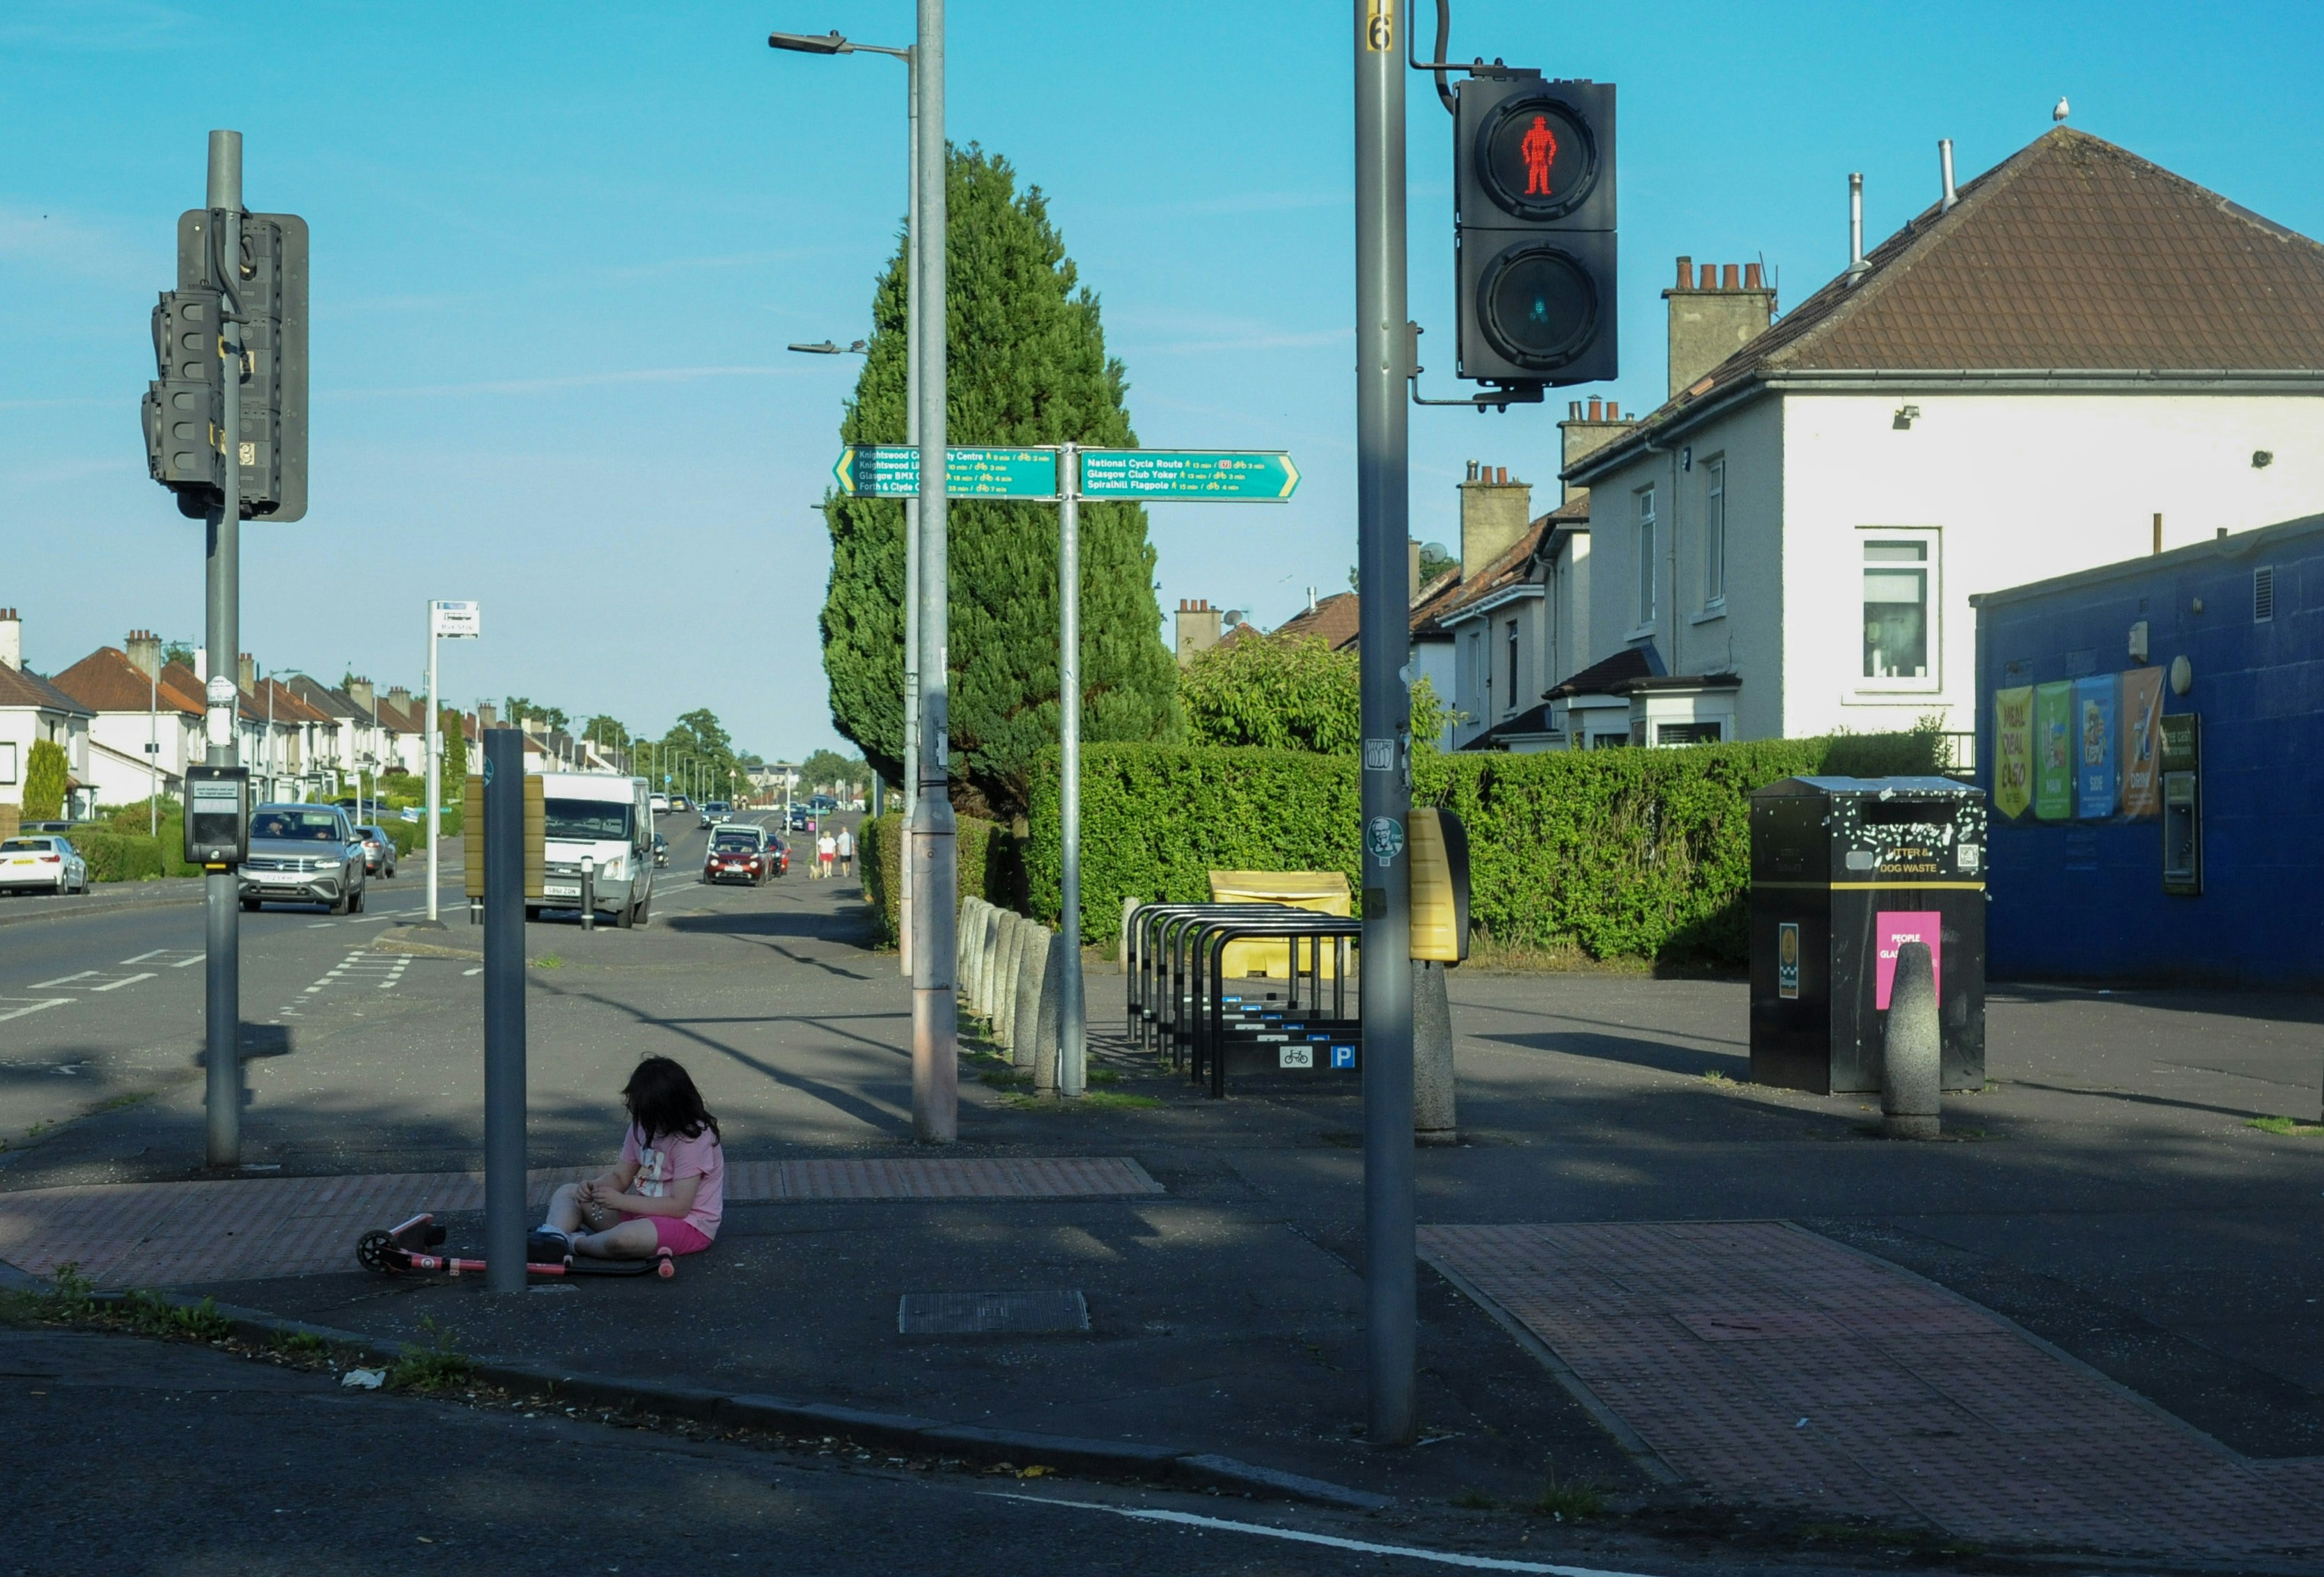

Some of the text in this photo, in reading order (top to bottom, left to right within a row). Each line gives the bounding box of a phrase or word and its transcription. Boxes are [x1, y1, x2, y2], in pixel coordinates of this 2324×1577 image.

[859, 451, 909, 460] Knightswood
[859, 462, 909, 470] Knightswood
[1087, 459, 1126, 467] National
[1128, 459, 1153, 469] Cycle
[1157, 460, 1183, 468] Route
[859, 472, 893, 481] Glasgow
[1087, 470, 1125, 480] Glasgow
[1128, 470, 1150, 478] Club
[890, 482, 913, 492] Clyde
[1087, 480, 1128, 489] Spiralhill
[1130, 480, 1169, 490] Flagpole
[2004, 705, 2025, 728] MEAL
[2002, 733, 2024, 755] DEAL
[2046, 778, 2061, 794] MAIN
[2089, 775, 2103, 791] SIDE
[1888, 848, 1929, 856] LITTER &
[1880, 864, 1937, 872] DOG WASTE
[1337, 1047, 1351, 1066] P
